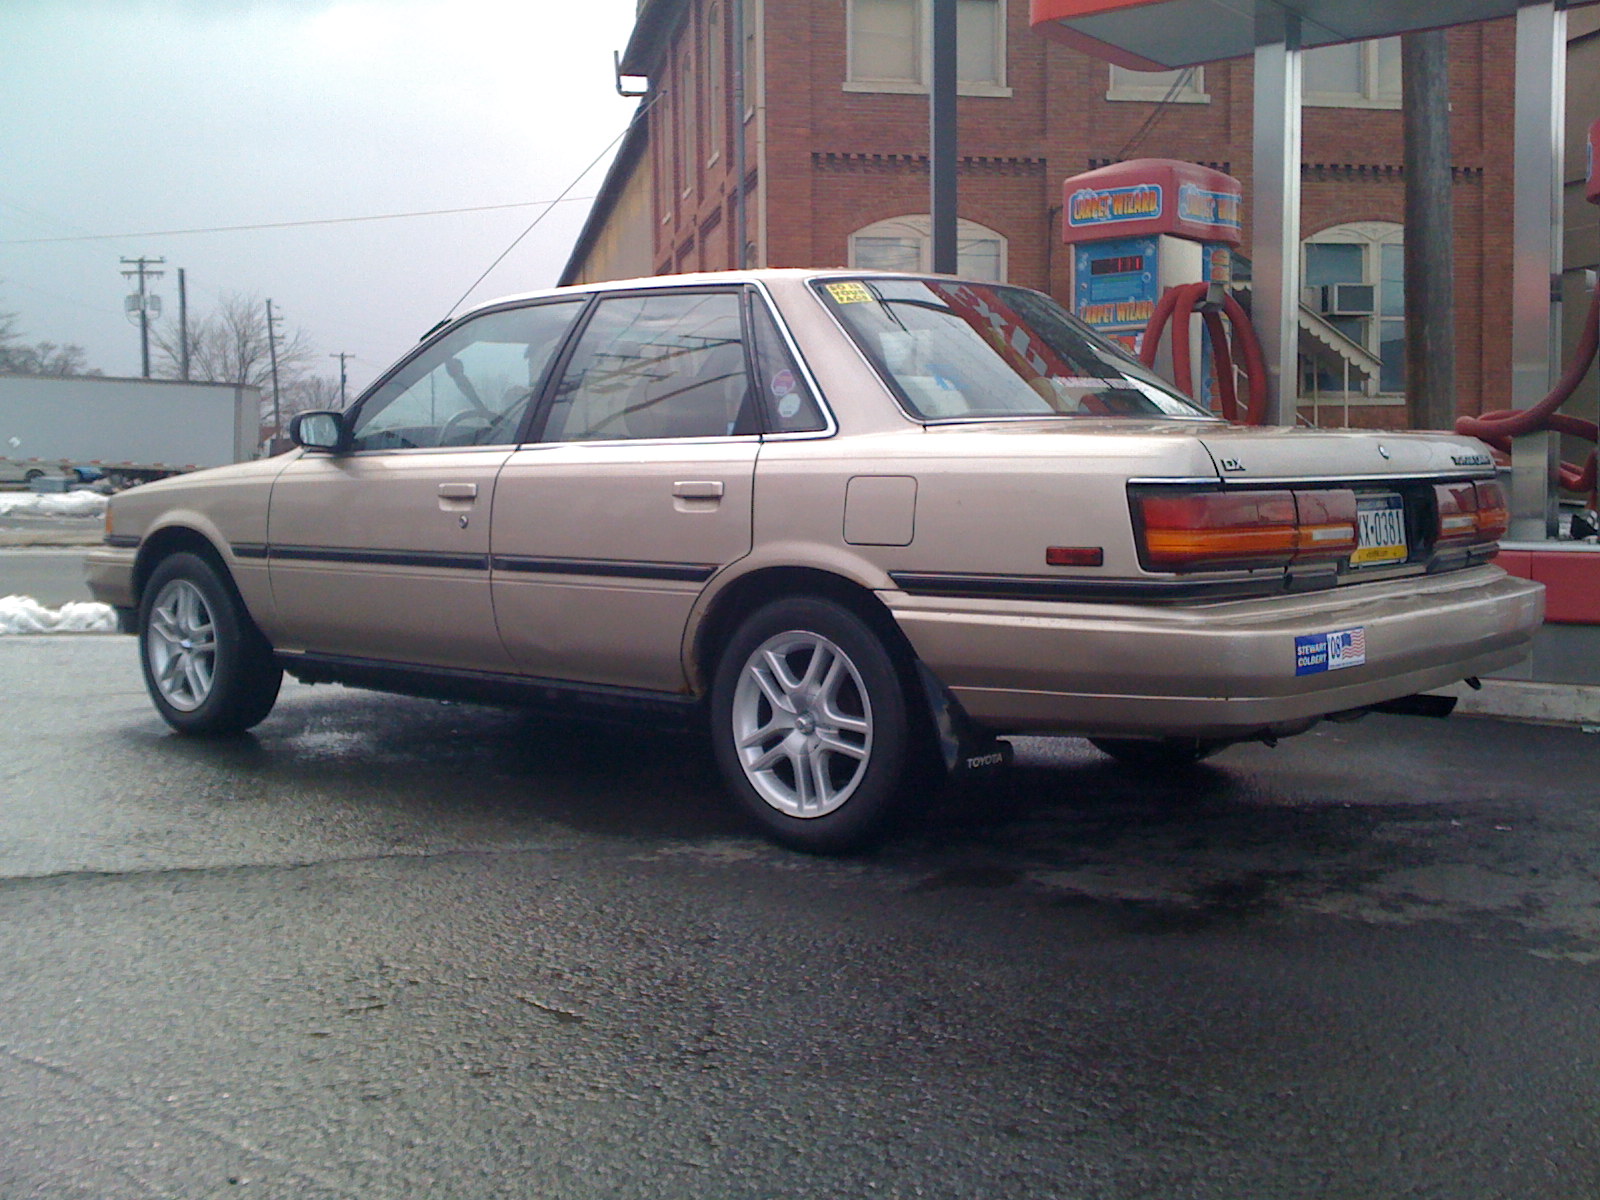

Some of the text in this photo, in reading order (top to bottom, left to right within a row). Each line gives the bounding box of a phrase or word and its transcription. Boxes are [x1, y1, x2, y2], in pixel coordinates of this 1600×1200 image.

[1297, 642, 1328, 655] STEWART
[1297, 654, 1328, 667] COLBERT
[967, 752, 1003, 769] TOYOTA
